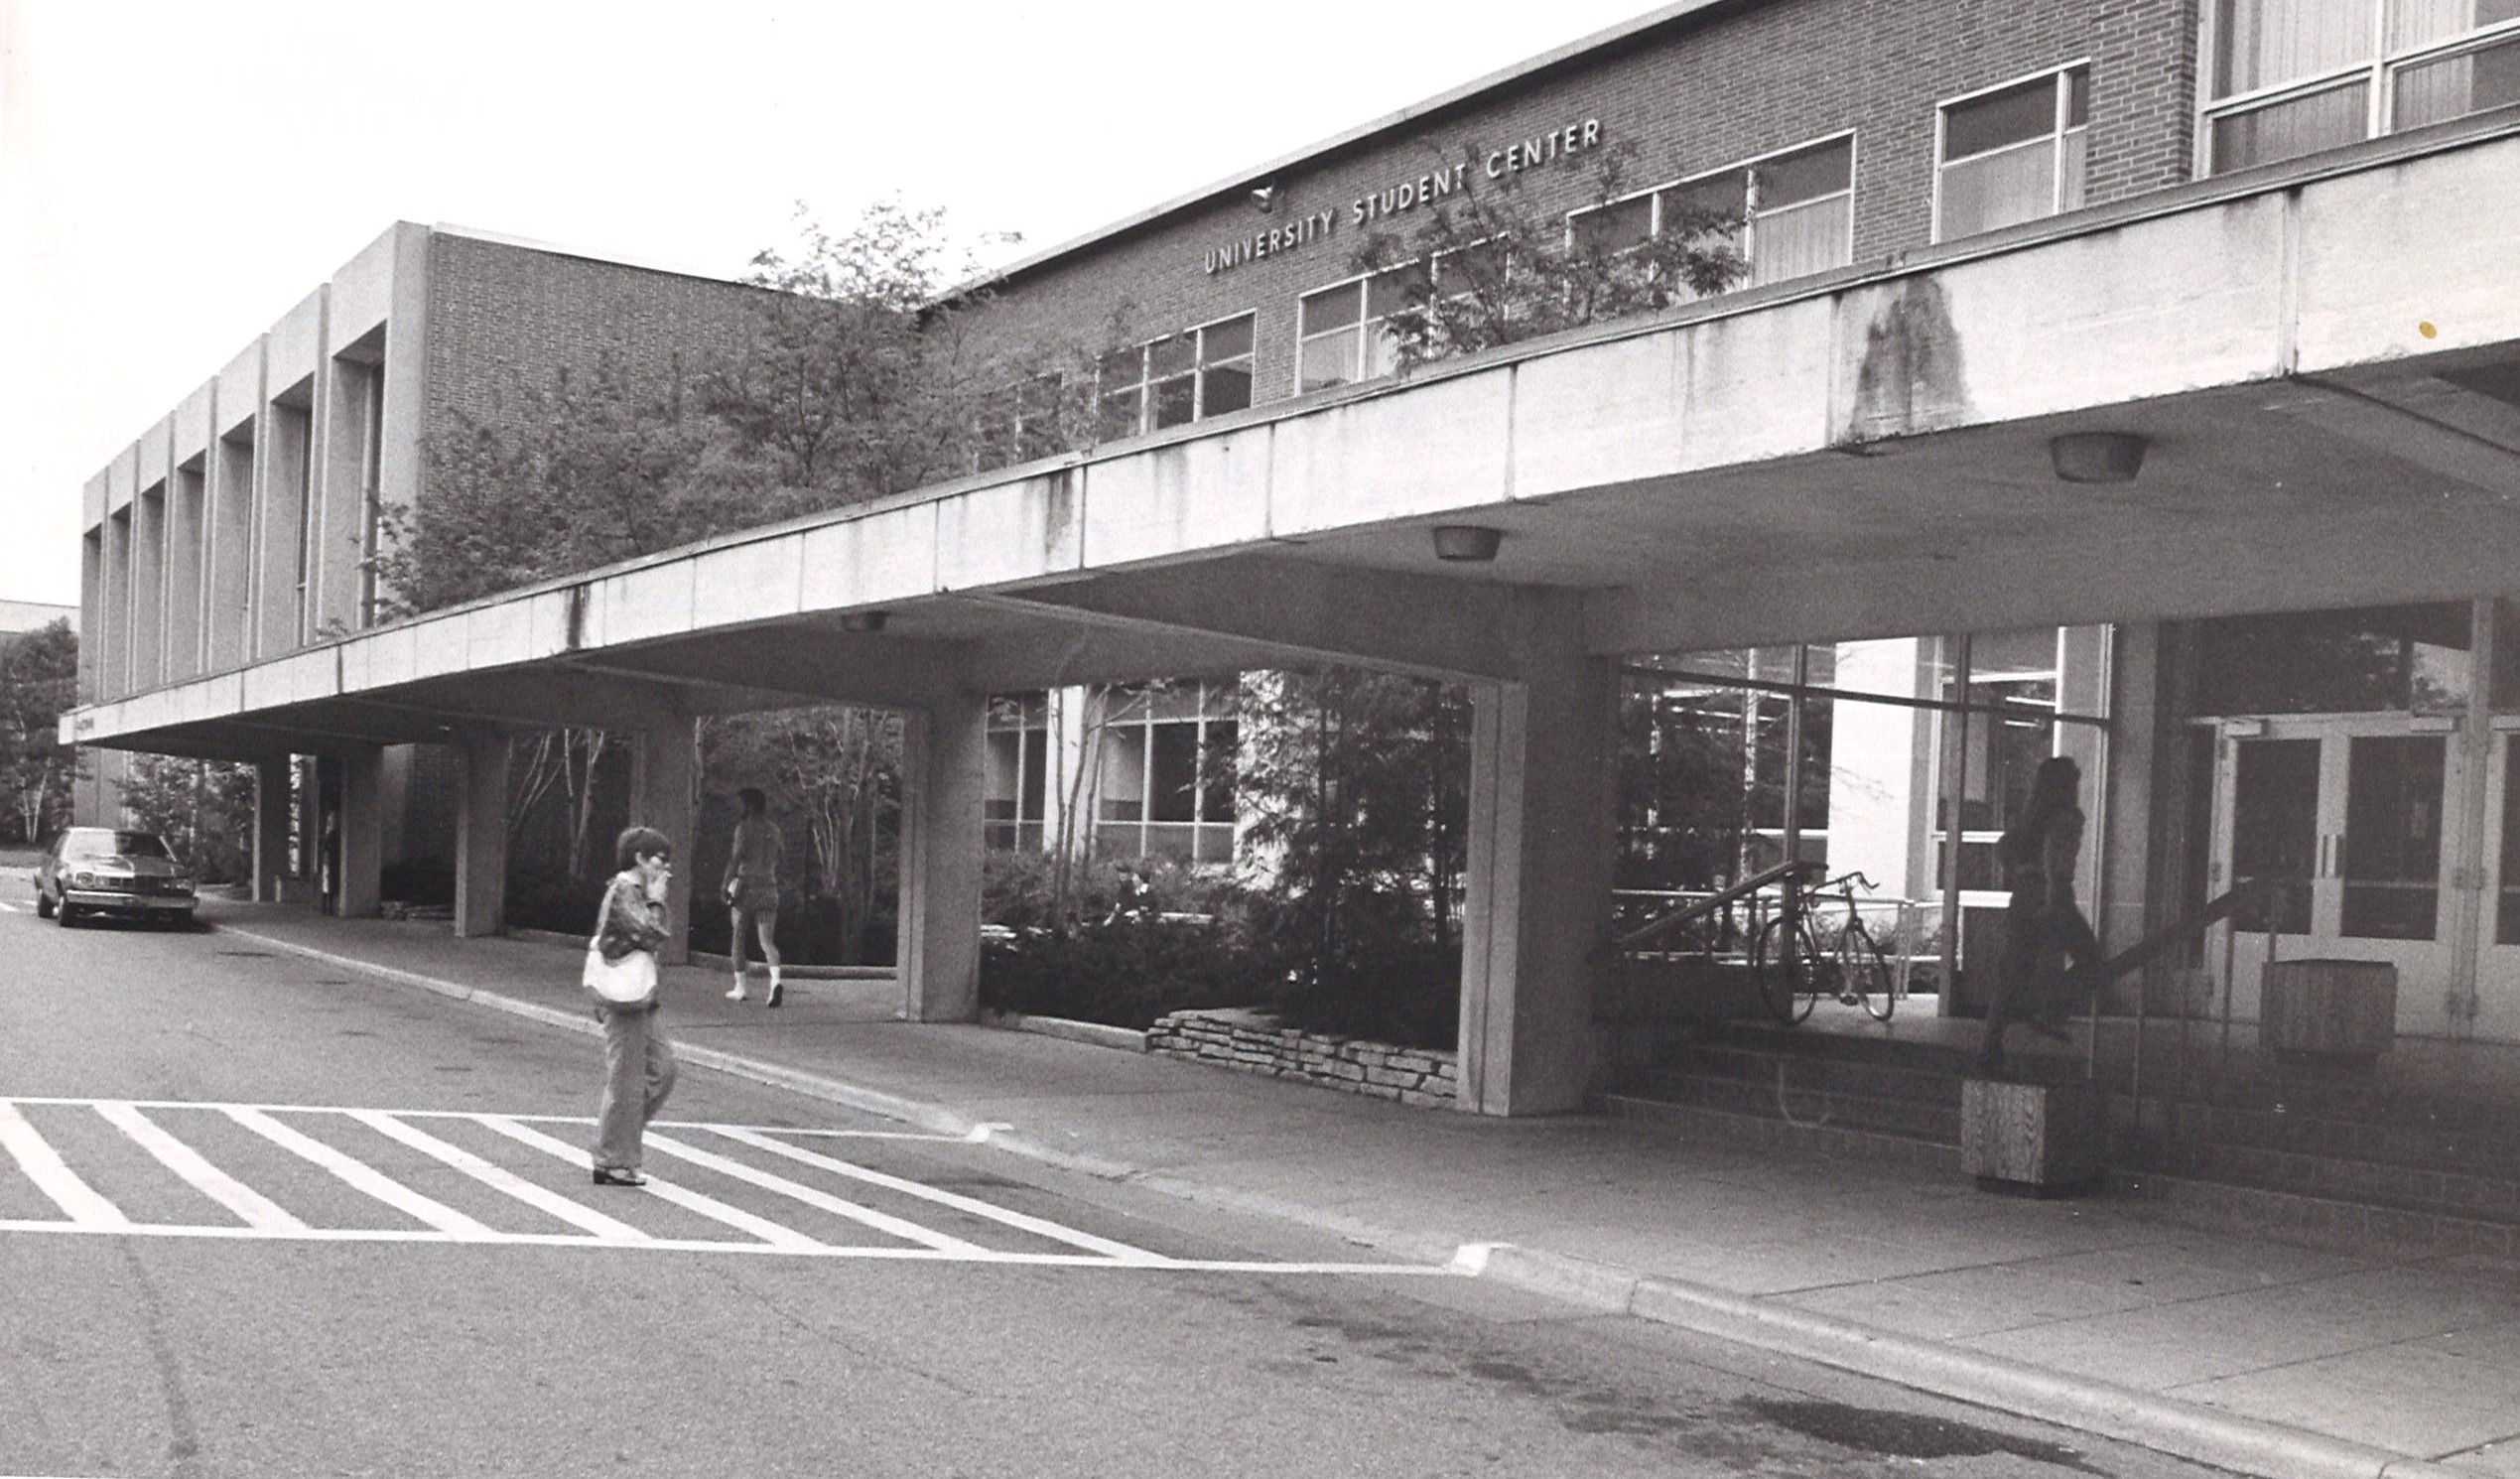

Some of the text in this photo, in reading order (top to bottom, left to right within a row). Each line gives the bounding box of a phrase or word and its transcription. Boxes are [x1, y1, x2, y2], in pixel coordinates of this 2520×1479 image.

[1205, 118, 1599, 273] UNIVERSITY STUDENT CENTER
